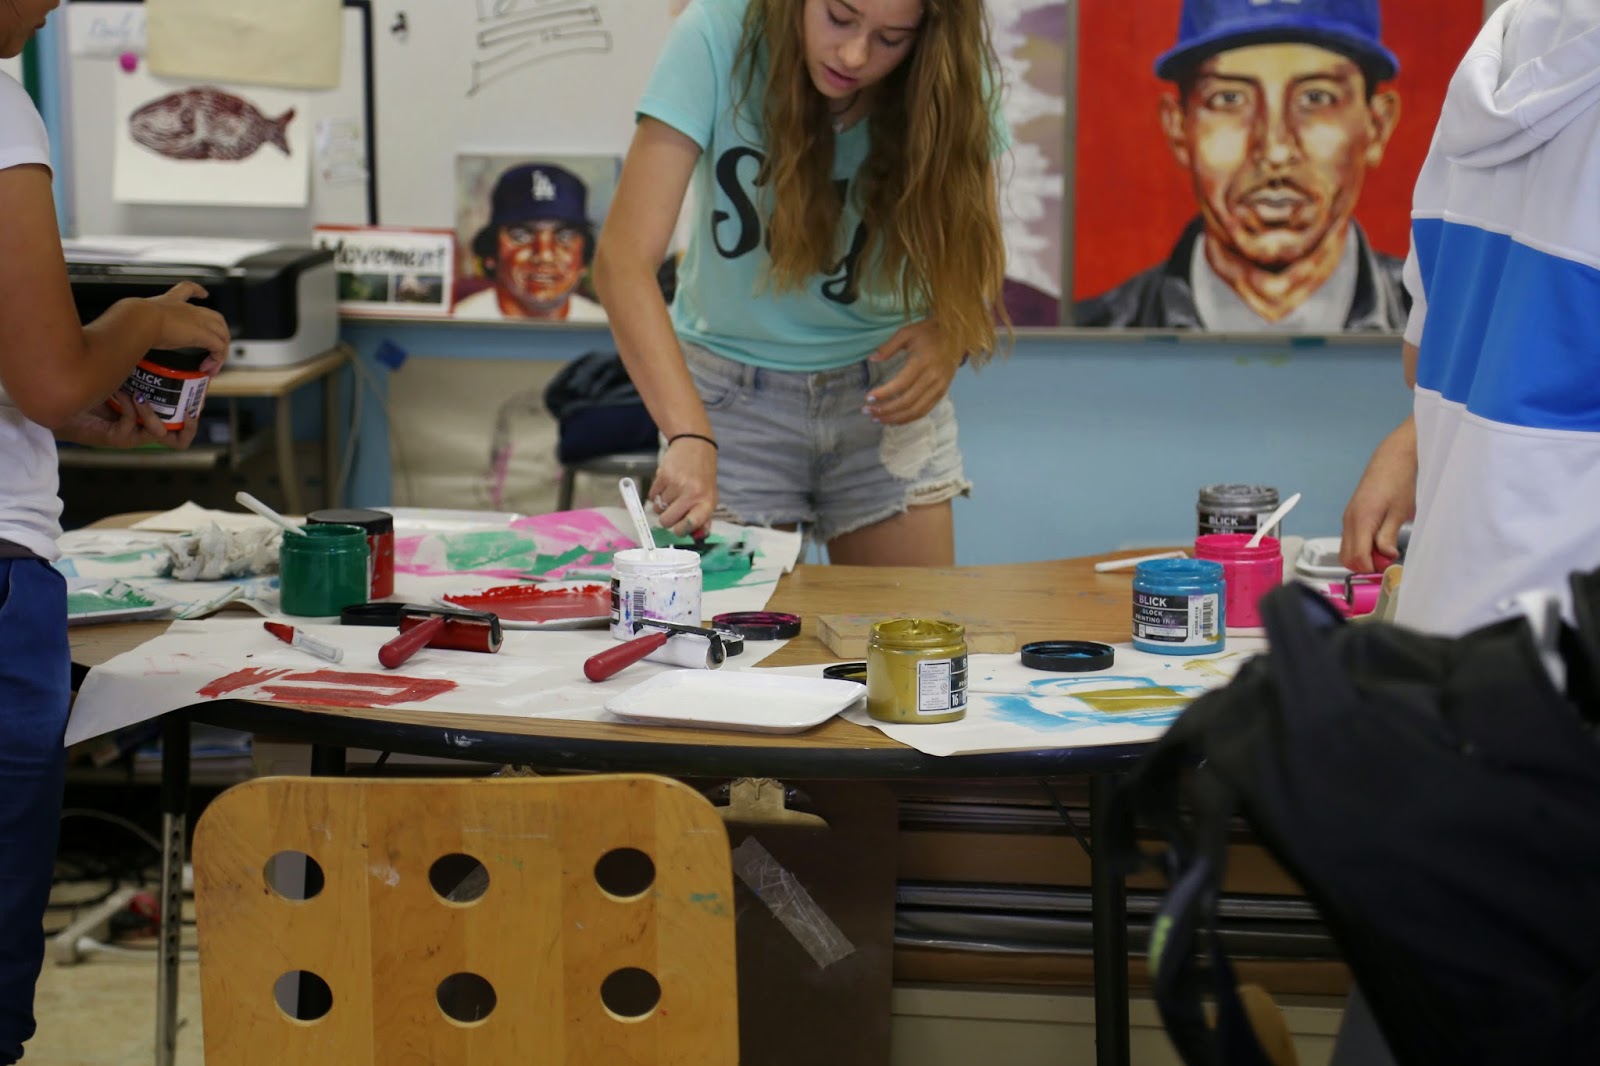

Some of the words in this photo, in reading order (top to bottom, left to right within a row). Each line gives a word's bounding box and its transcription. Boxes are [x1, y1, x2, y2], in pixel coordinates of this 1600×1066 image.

[131, 380, 155, 393] BLOCK
[153, 395, 167, 403] INK
[1208, 515, 1239, 526] BLICK
[1138, 594, 1167, 608] BLICK
[1141, 607, 1163, 617] BLOCK
[1135, 613, 1161, 624] PRINTING
[951, 693, 959, 706] 16
